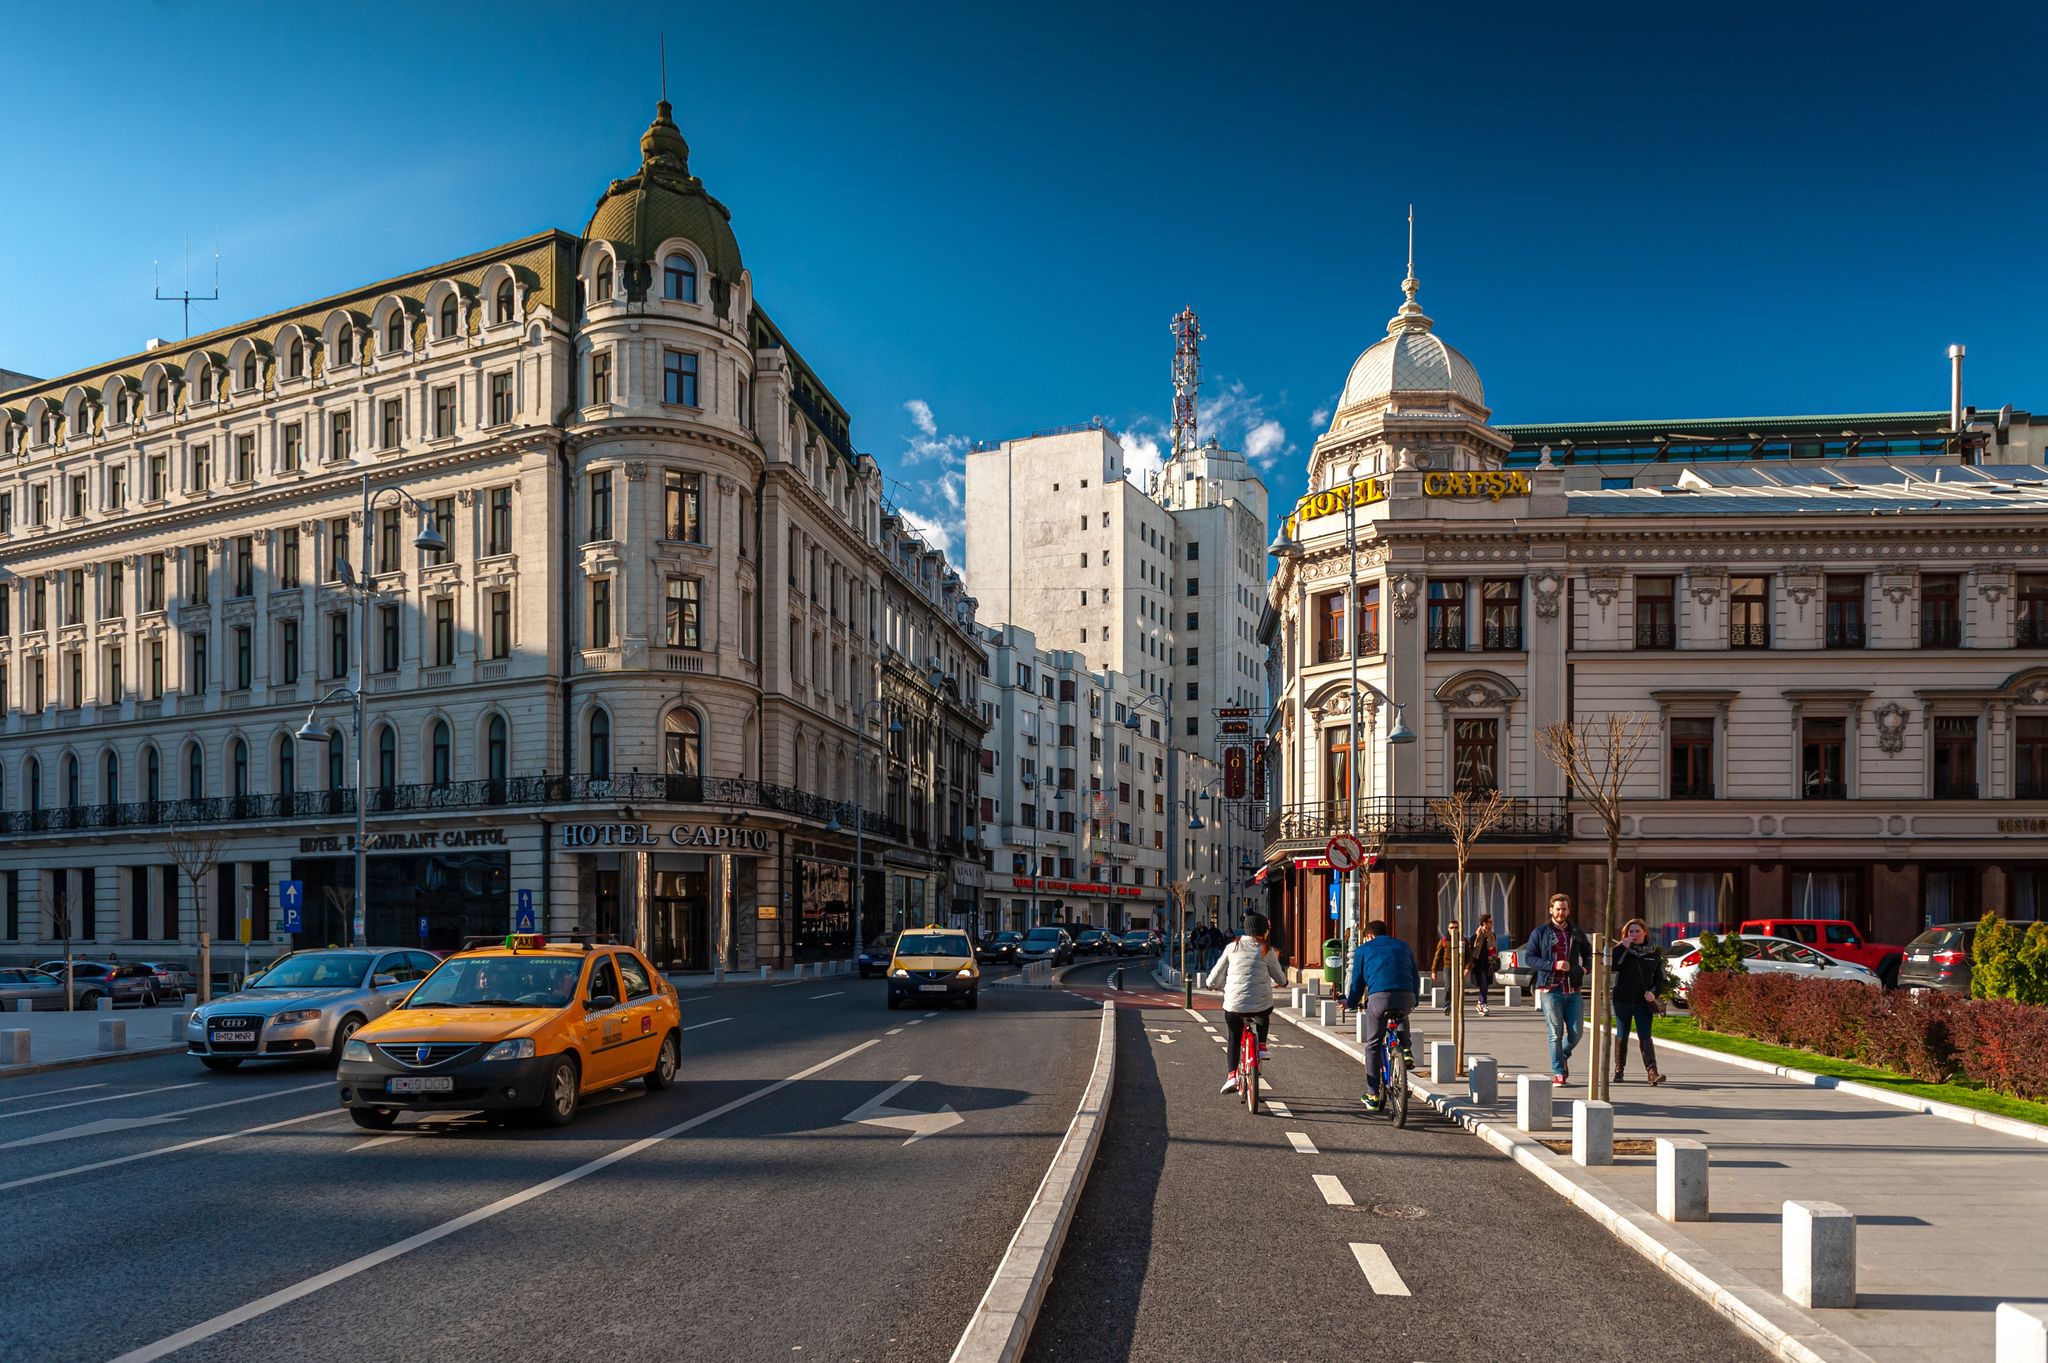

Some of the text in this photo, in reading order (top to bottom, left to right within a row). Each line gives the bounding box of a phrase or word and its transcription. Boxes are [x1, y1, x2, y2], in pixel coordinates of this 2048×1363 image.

[1302, 478, 1384, 520] HOTEL
[300, 836, 342, 853] HOTEL
[443, 829, 508, 847] CAPITOL
[562, 824, 772, 850] HOTEL CAPITOL
[288, 910, 298, 924] P
[513, 936, 533, 947] TAXI
